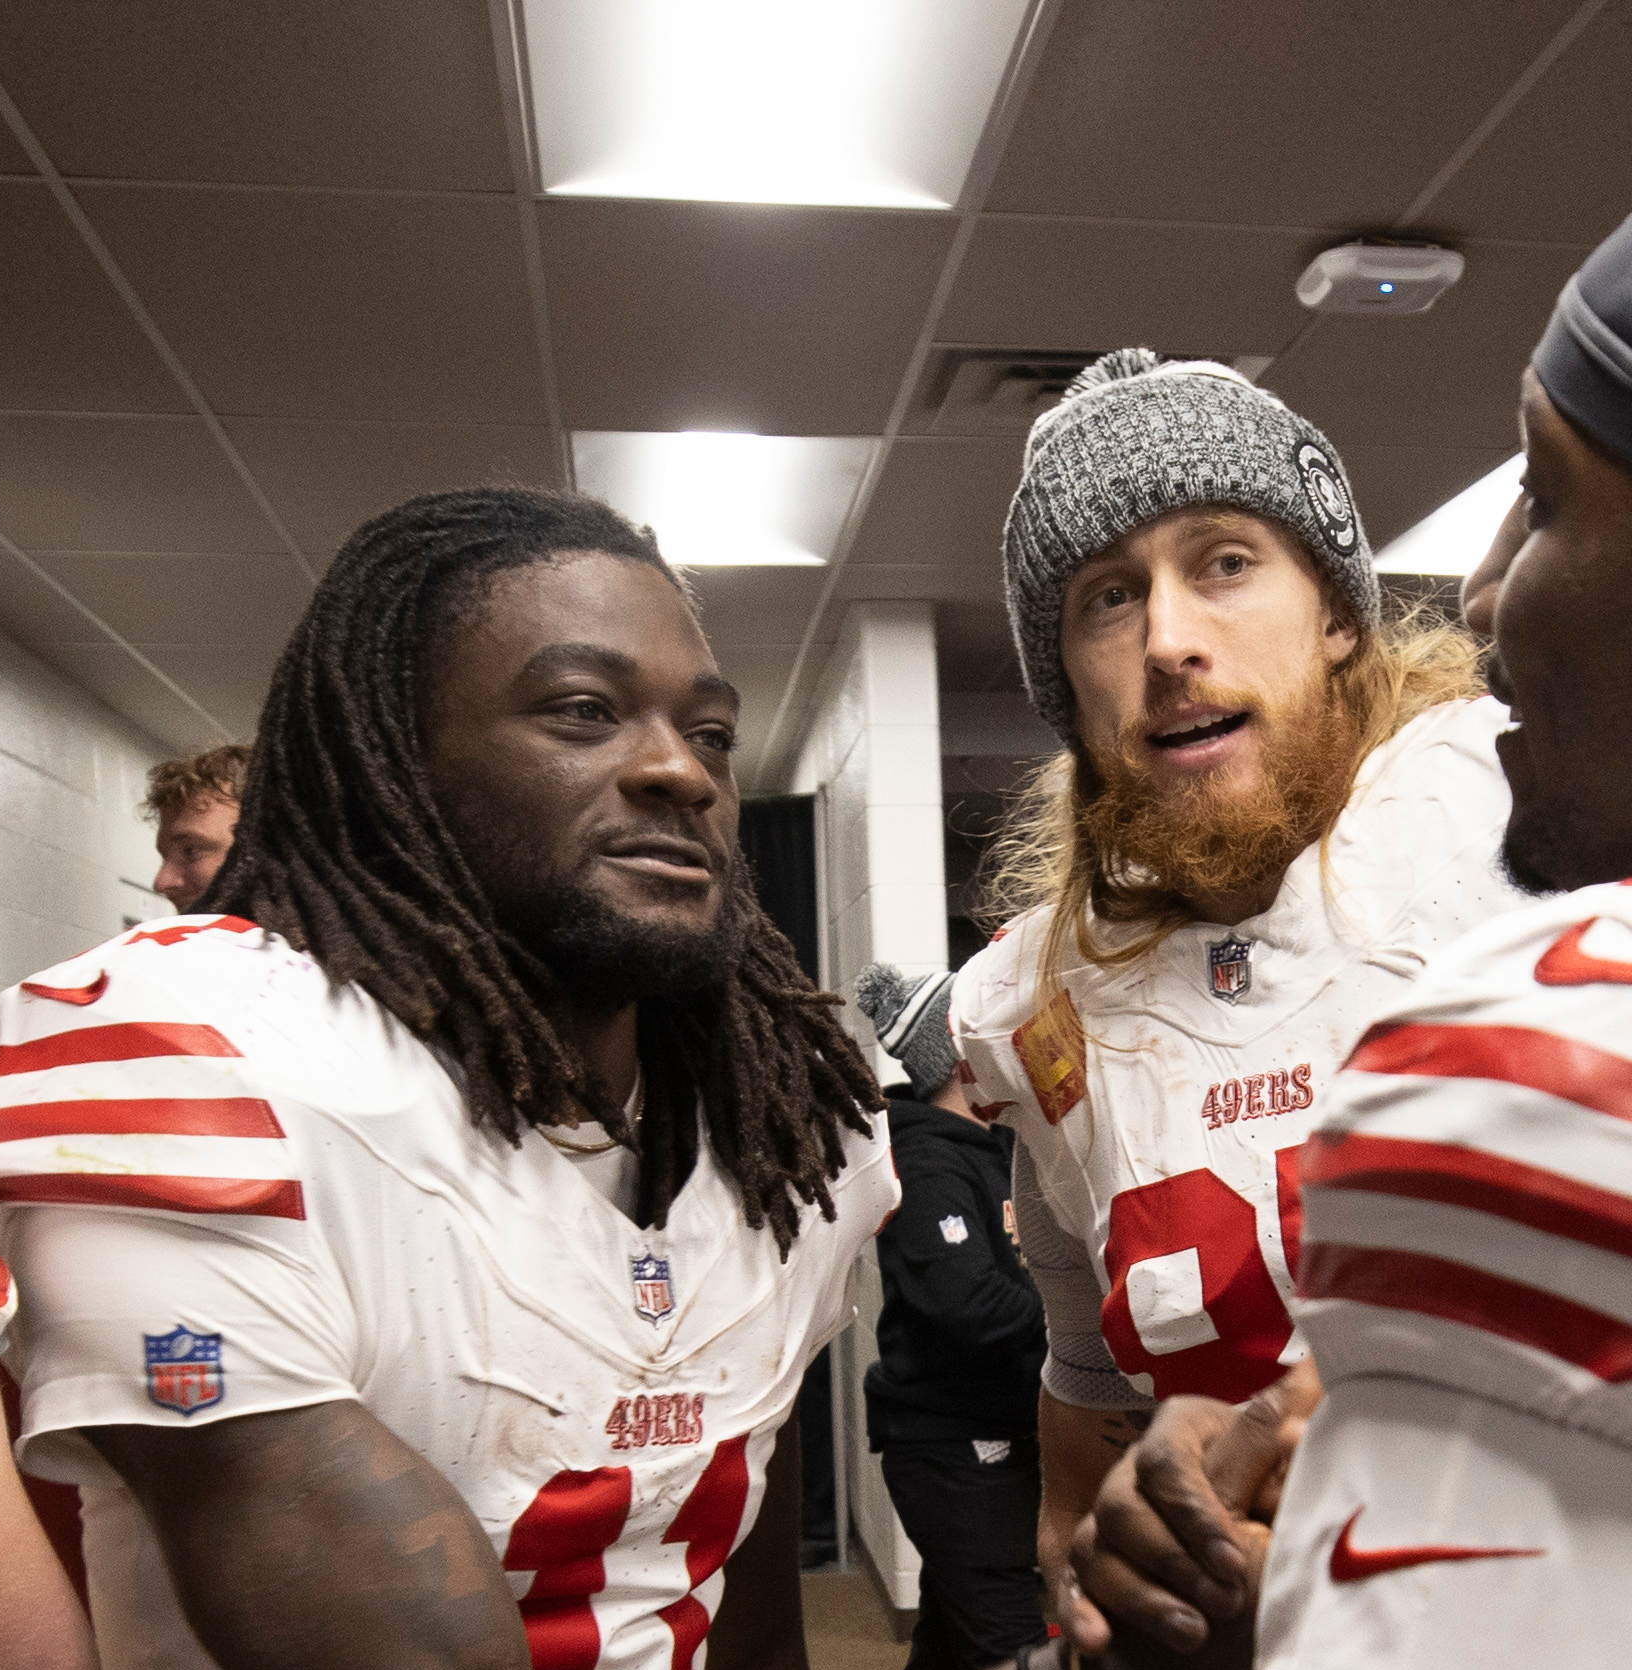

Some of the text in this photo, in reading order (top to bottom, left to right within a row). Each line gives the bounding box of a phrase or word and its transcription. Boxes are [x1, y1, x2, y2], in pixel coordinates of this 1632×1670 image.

[1213, 962, 1246, 992] NFL
[1201, 1063, 1314, 1131] 49ERS
[637, 1281, 671, 1312] NFL
[151, 1365, 219, 1407] NFL
[605, 1392, 706, 1450] 49ERS
